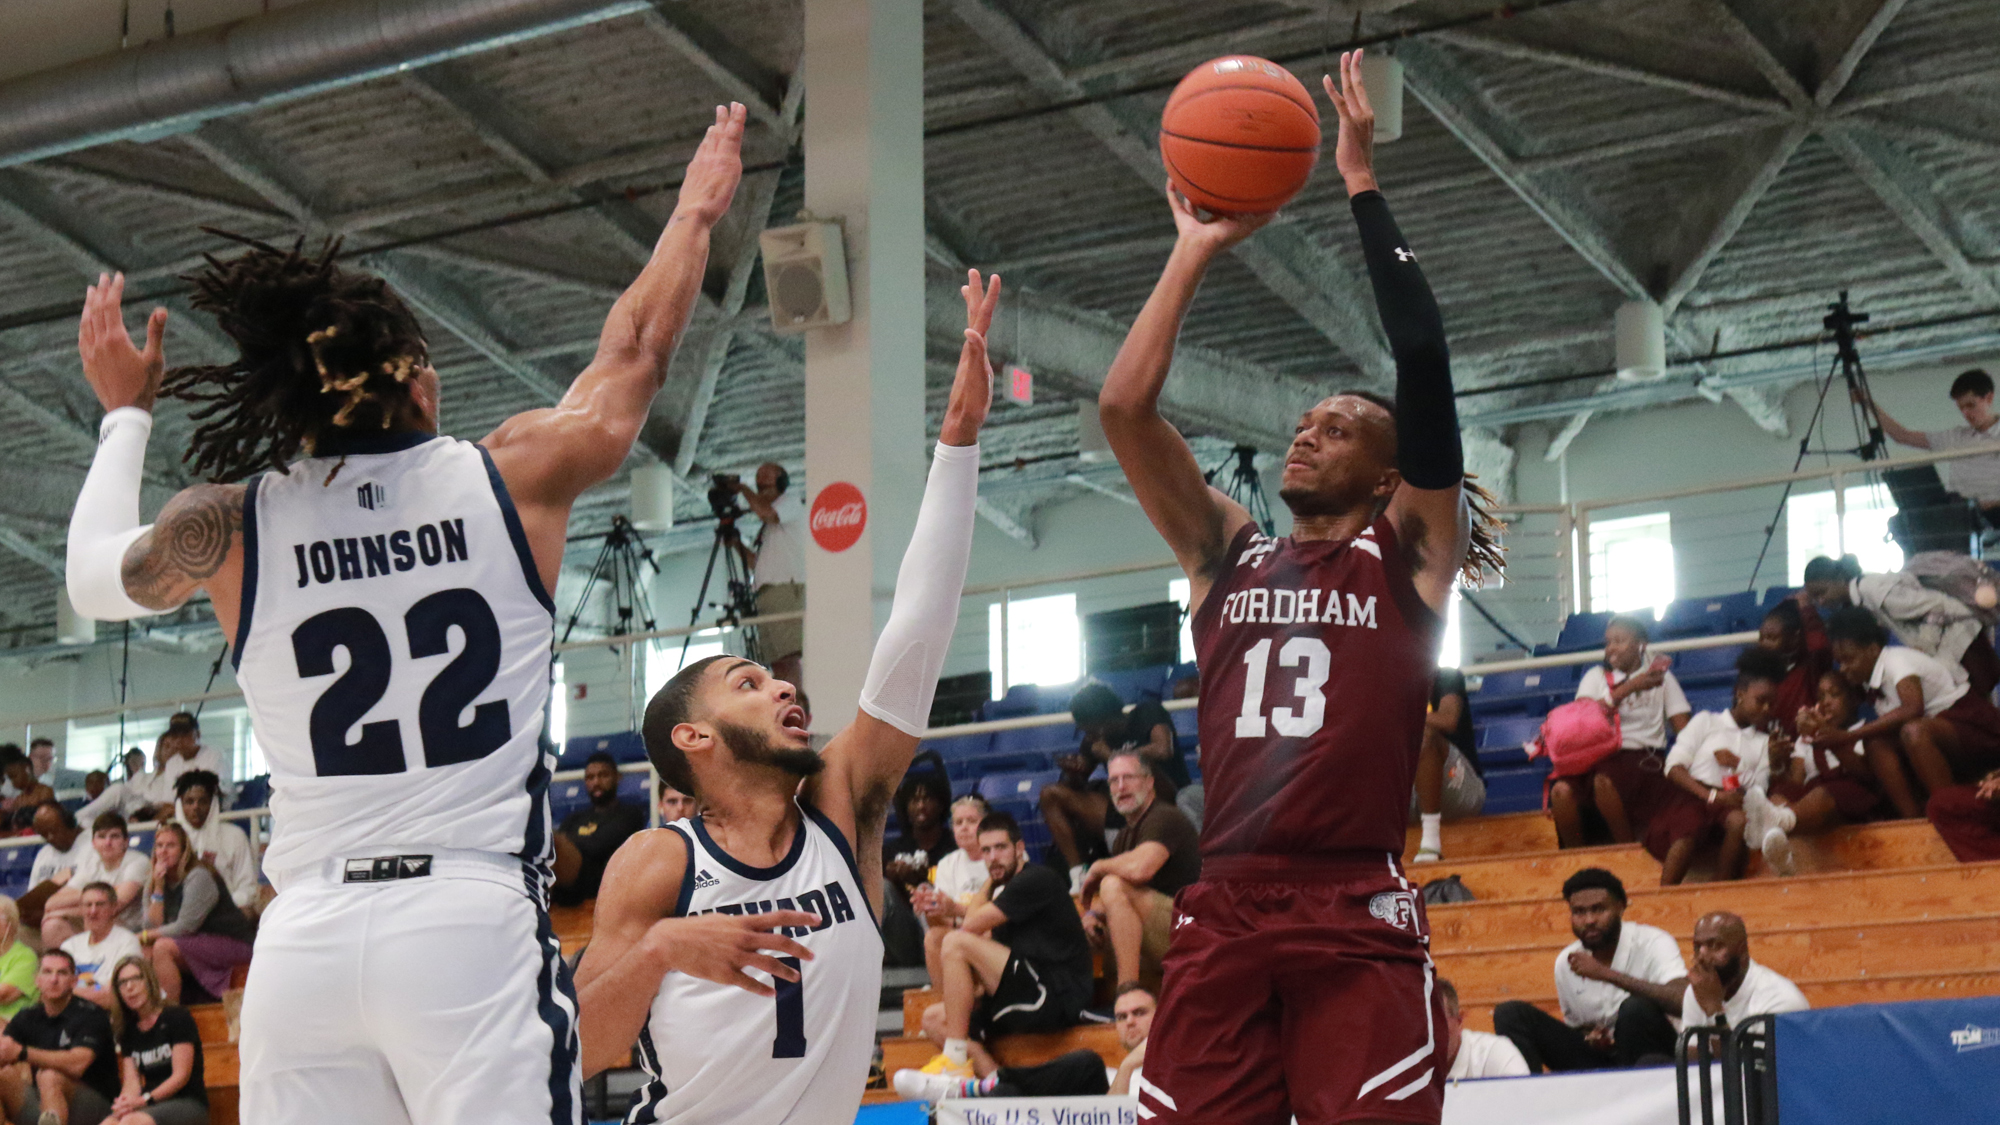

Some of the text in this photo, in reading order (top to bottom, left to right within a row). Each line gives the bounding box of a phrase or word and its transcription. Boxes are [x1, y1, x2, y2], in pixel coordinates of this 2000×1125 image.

[294, 518, 468, 588] JOHNSON
[1220, 588, 1378, 629] FORDHAM
[291, 588, 512, 777] 22
[1235, 637, 1331, 738] 13
[688, 881, 856, 939] ADA
[770, 956, 807, 1059] 1
[963, 1106, 1138, 1125] The U.S. Virgin Is
